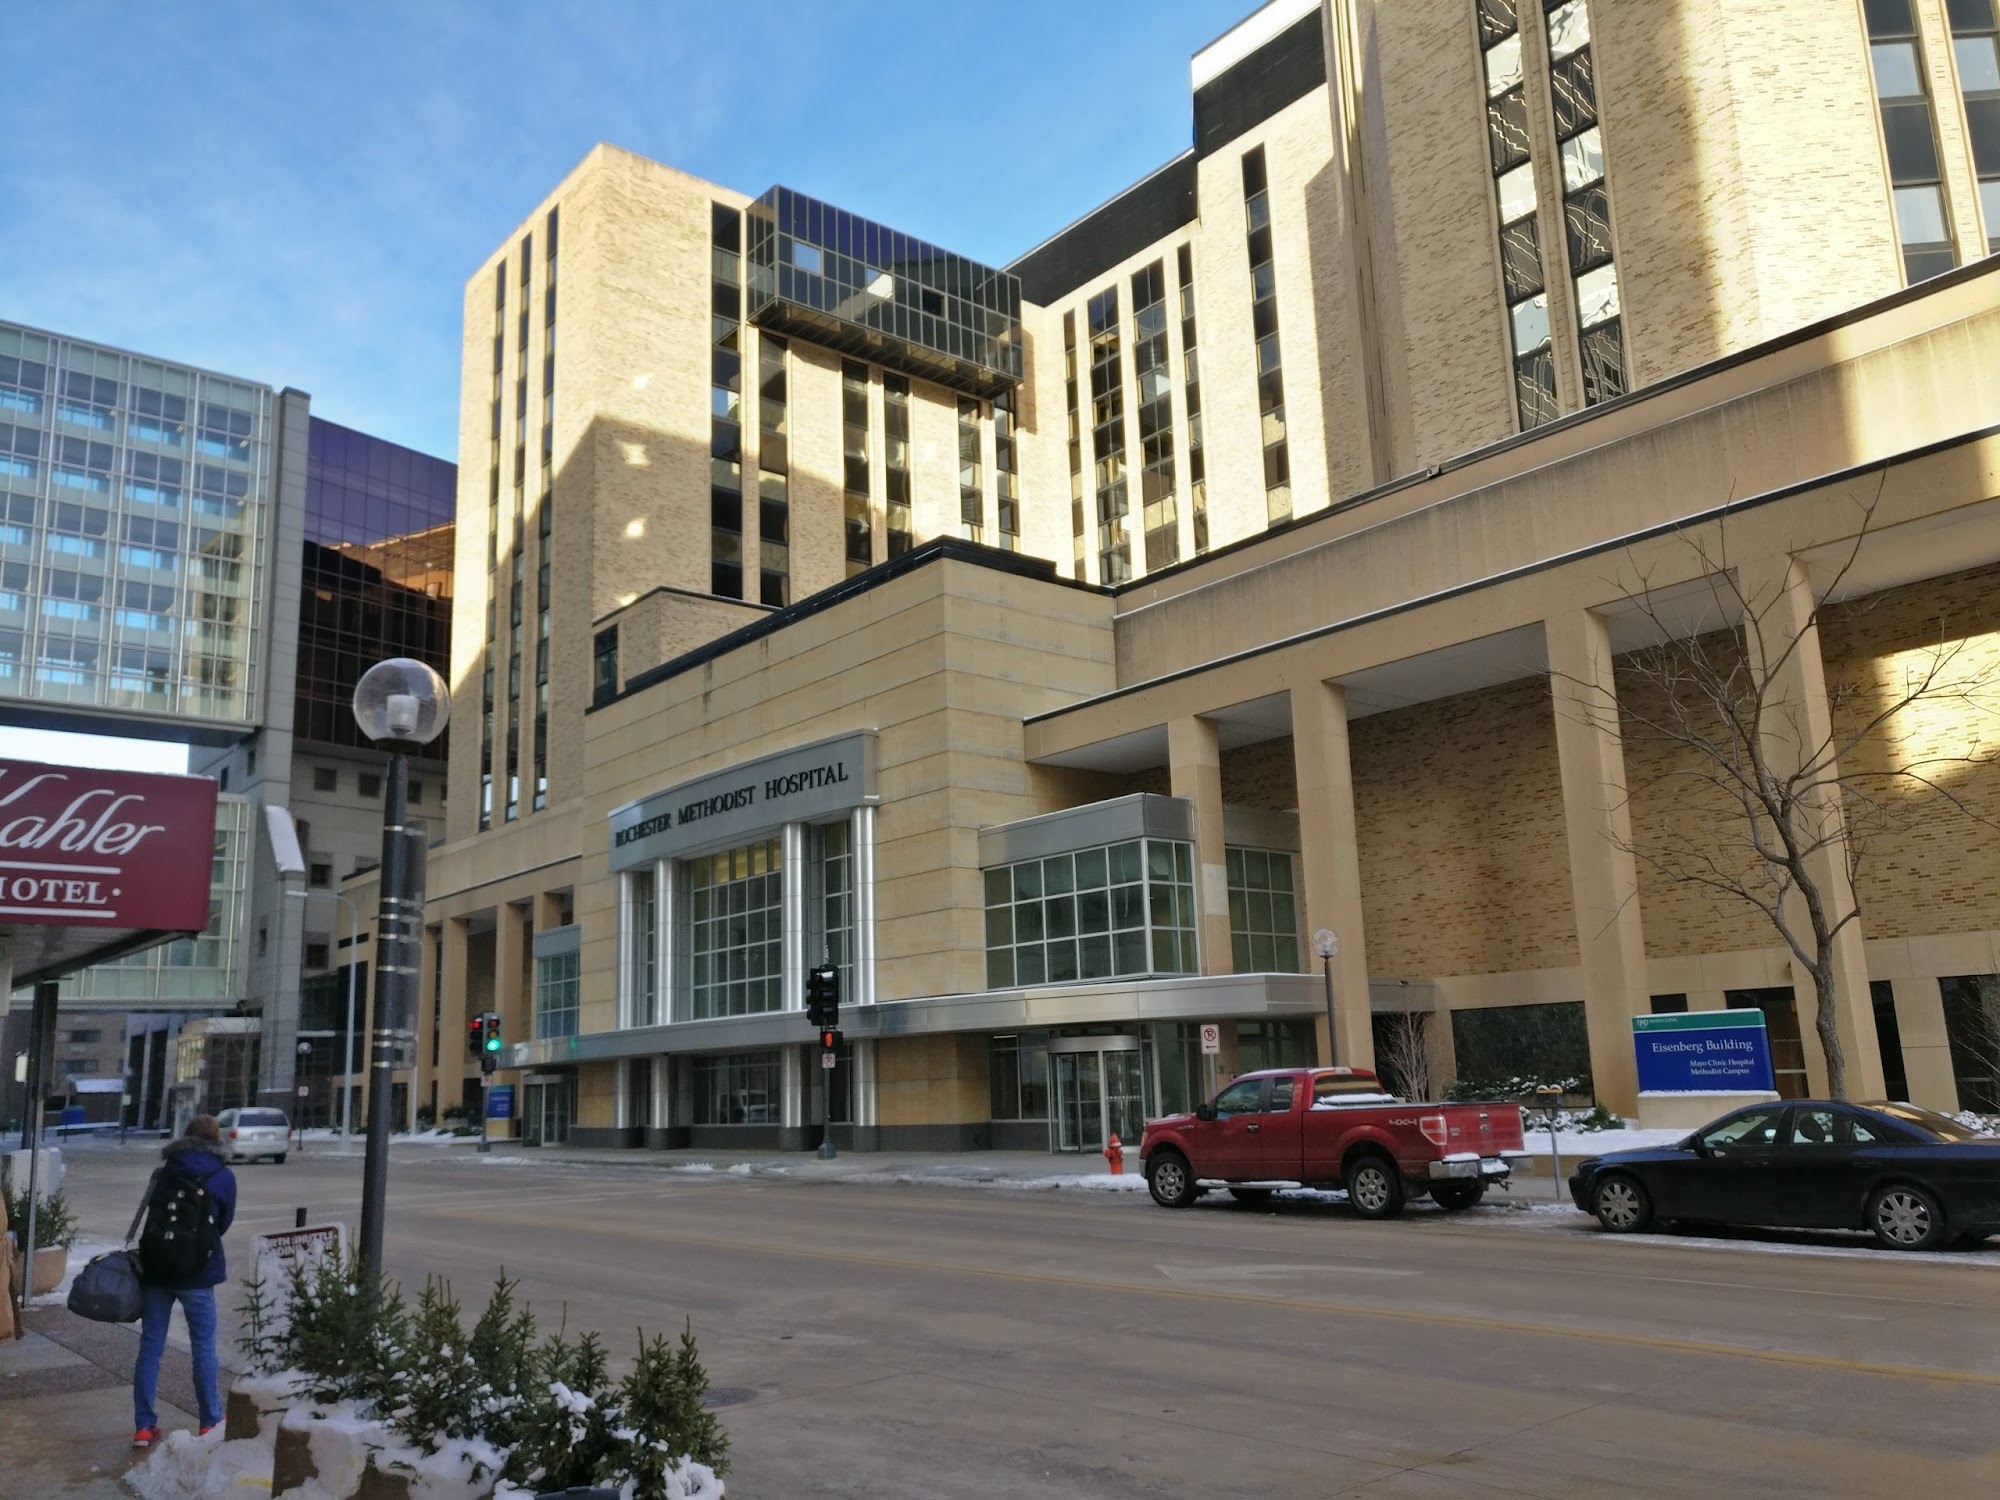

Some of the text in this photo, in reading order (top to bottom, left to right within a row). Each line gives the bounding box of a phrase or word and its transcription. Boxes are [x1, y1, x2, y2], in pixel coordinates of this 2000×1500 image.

[614, 762, 848, 848] ROCHESTER METHODIST HOSPITAL
[1652, 1039, 1754, 1054] Eisenberg Building
[1689, 1058, 1755, 1068] Mayo Clinic Hospital
[1690, 1067, 1750, 1076] Methodist Campus
